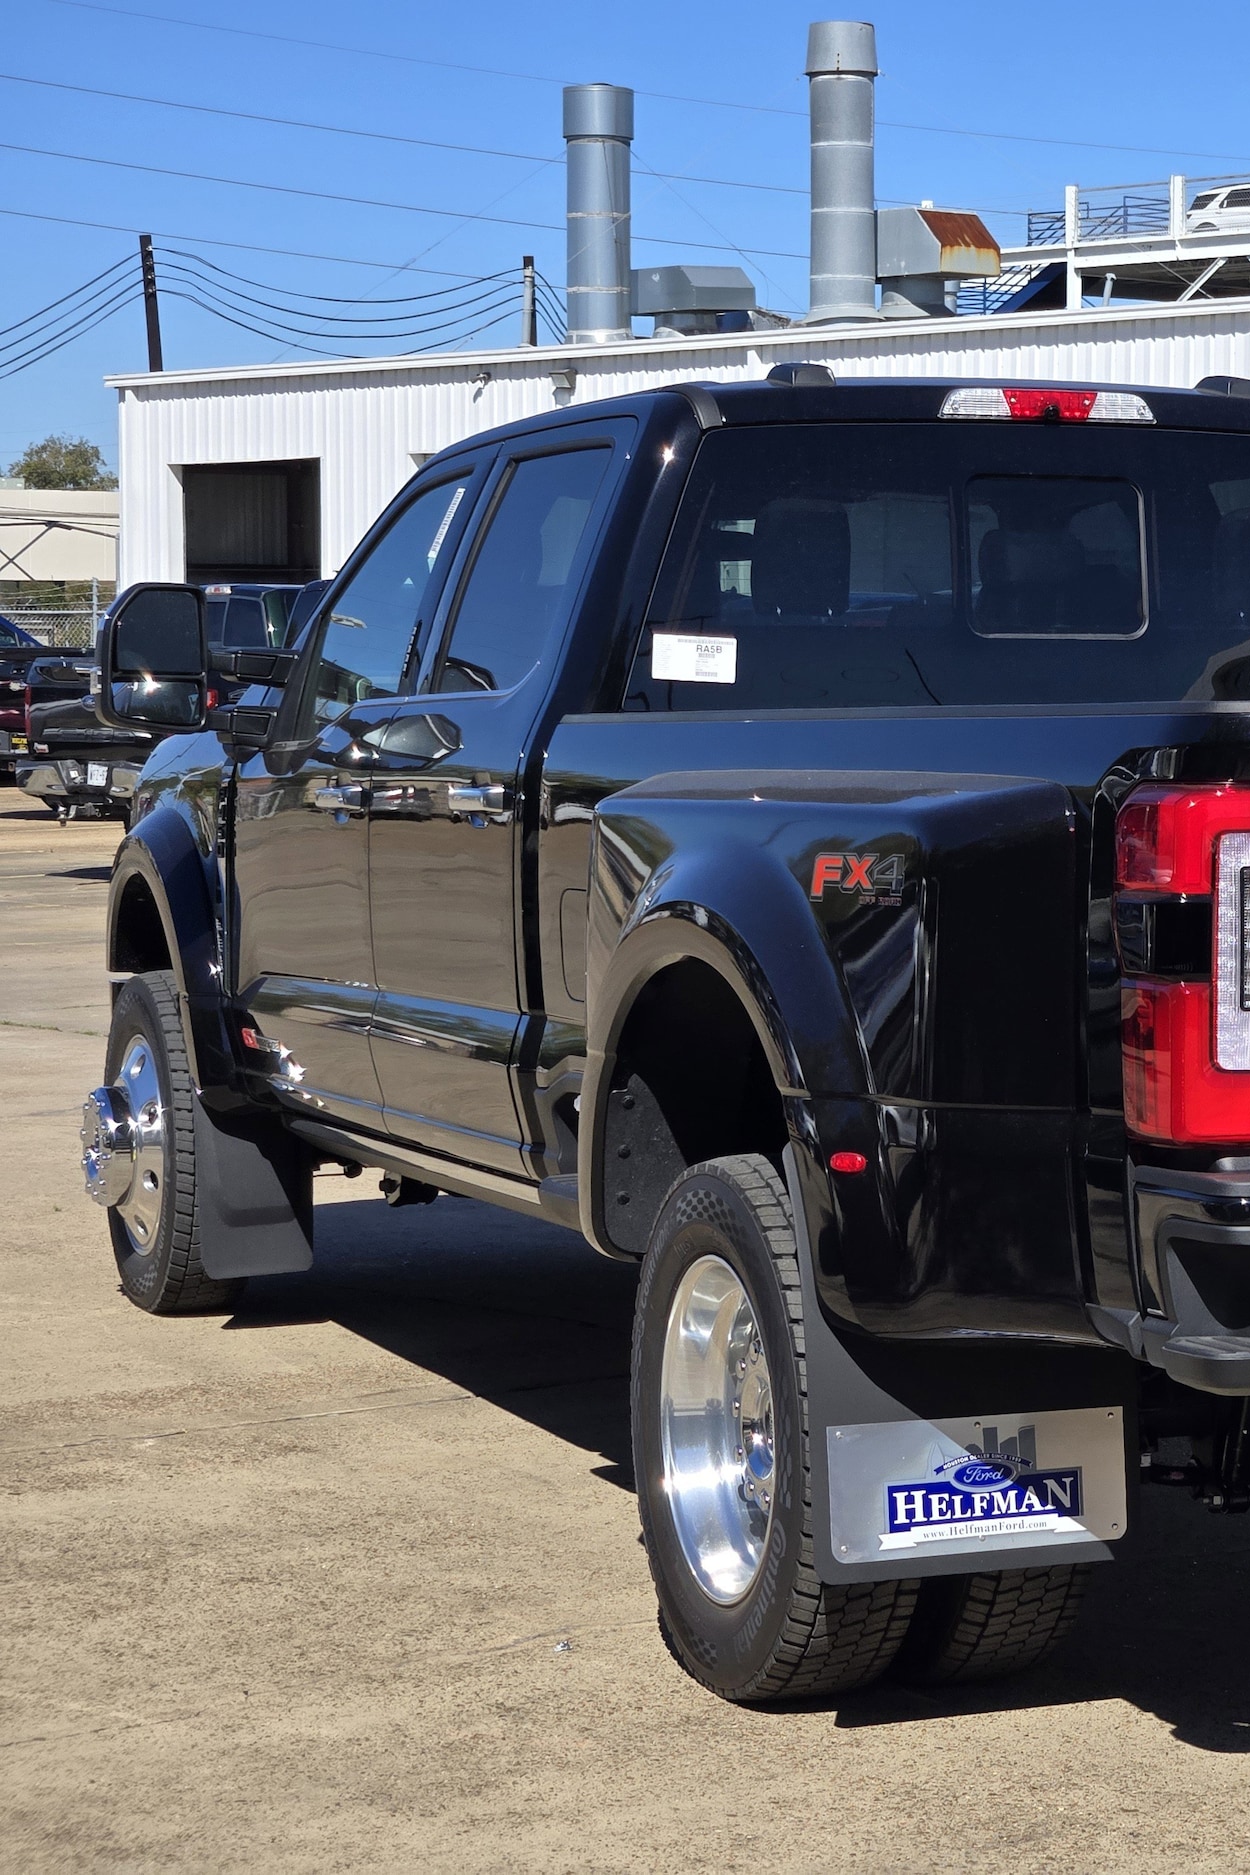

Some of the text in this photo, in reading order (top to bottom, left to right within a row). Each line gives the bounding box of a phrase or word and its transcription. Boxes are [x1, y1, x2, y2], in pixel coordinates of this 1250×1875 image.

[809, 852, 905, 902] FX4
[942, 1456, 970, 1470] HOUSTON
[963, 1465, 1004, 1483] Ford
[891, 1476, 1075, 1525] HELFMAN
[922, 1519, 1048, 1540] www.HelfmanFord.com
